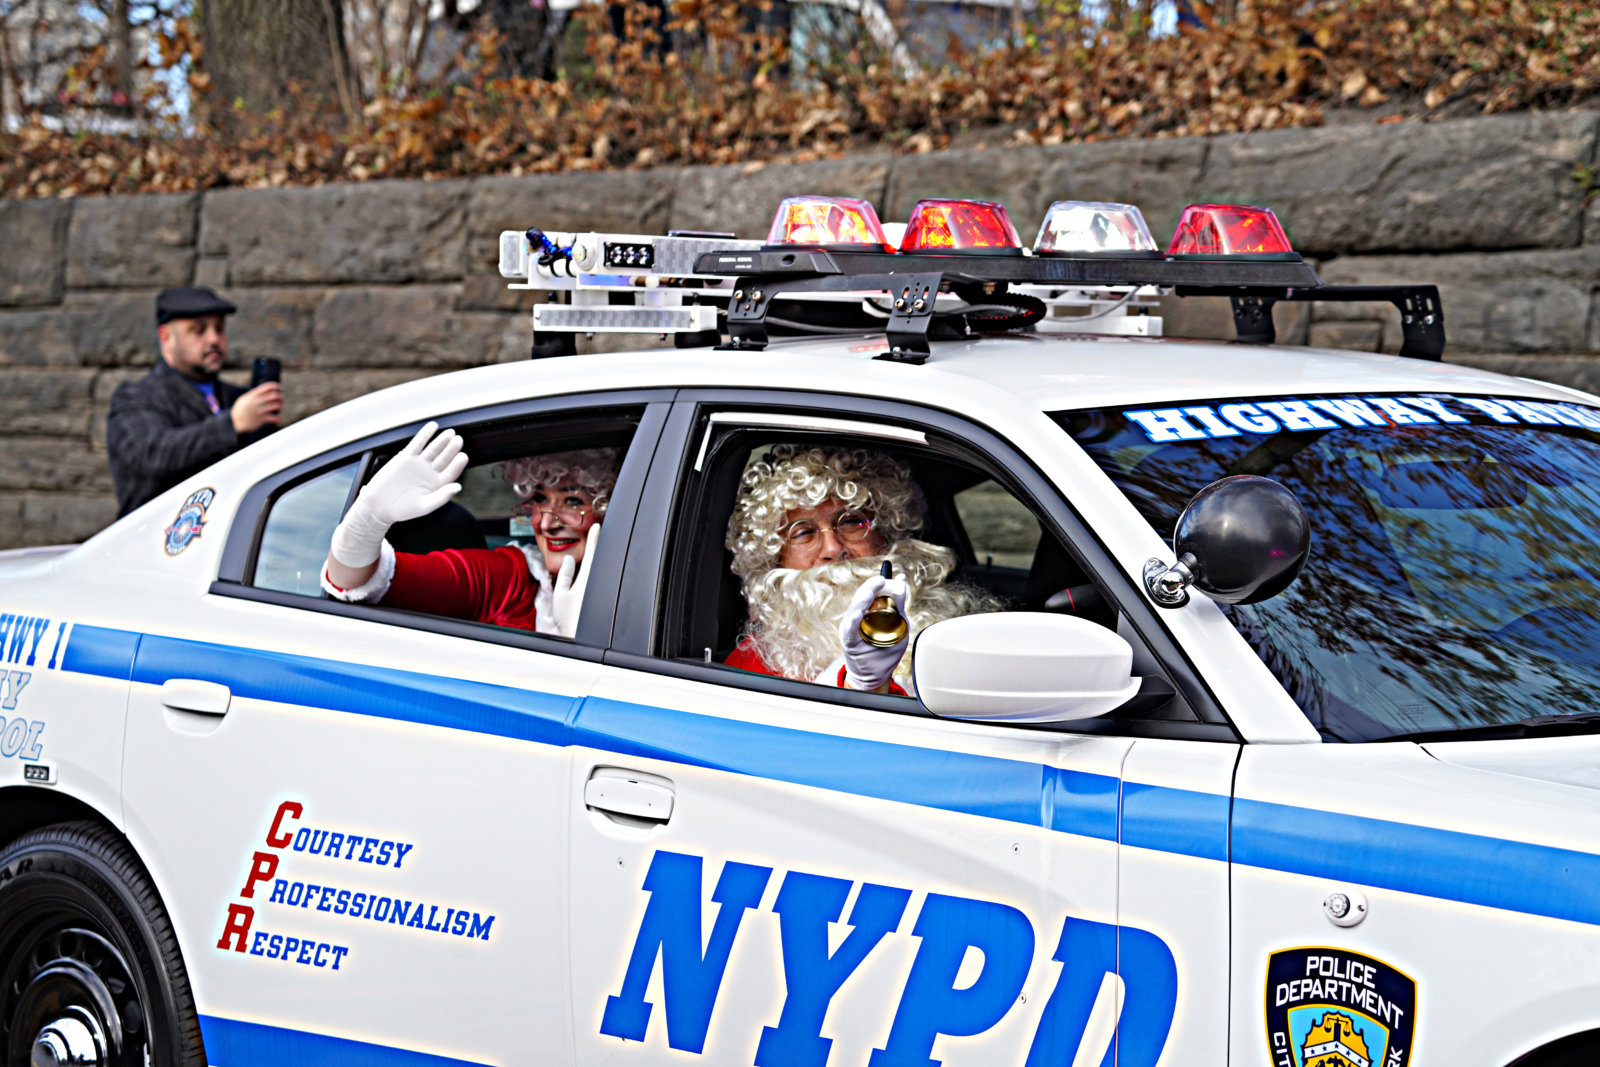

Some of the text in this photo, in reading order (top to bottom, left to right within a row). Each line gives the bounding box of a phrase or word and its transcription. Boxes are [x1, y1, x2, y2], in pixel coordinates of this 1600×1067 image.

[1122, 397, 1470, 443] HIGHWAY
[266, 800, 413, 868] COURTESY
[240, 851, 495, 941] PROFESSIONALISM
[216, 902, 349, 970] RESPECT
[600, 849, 1178, 1067] NYPD
[1275, 979, 1404, 1030] DEPARTMENT
[1306, 956, 1377, 989] POLICE
